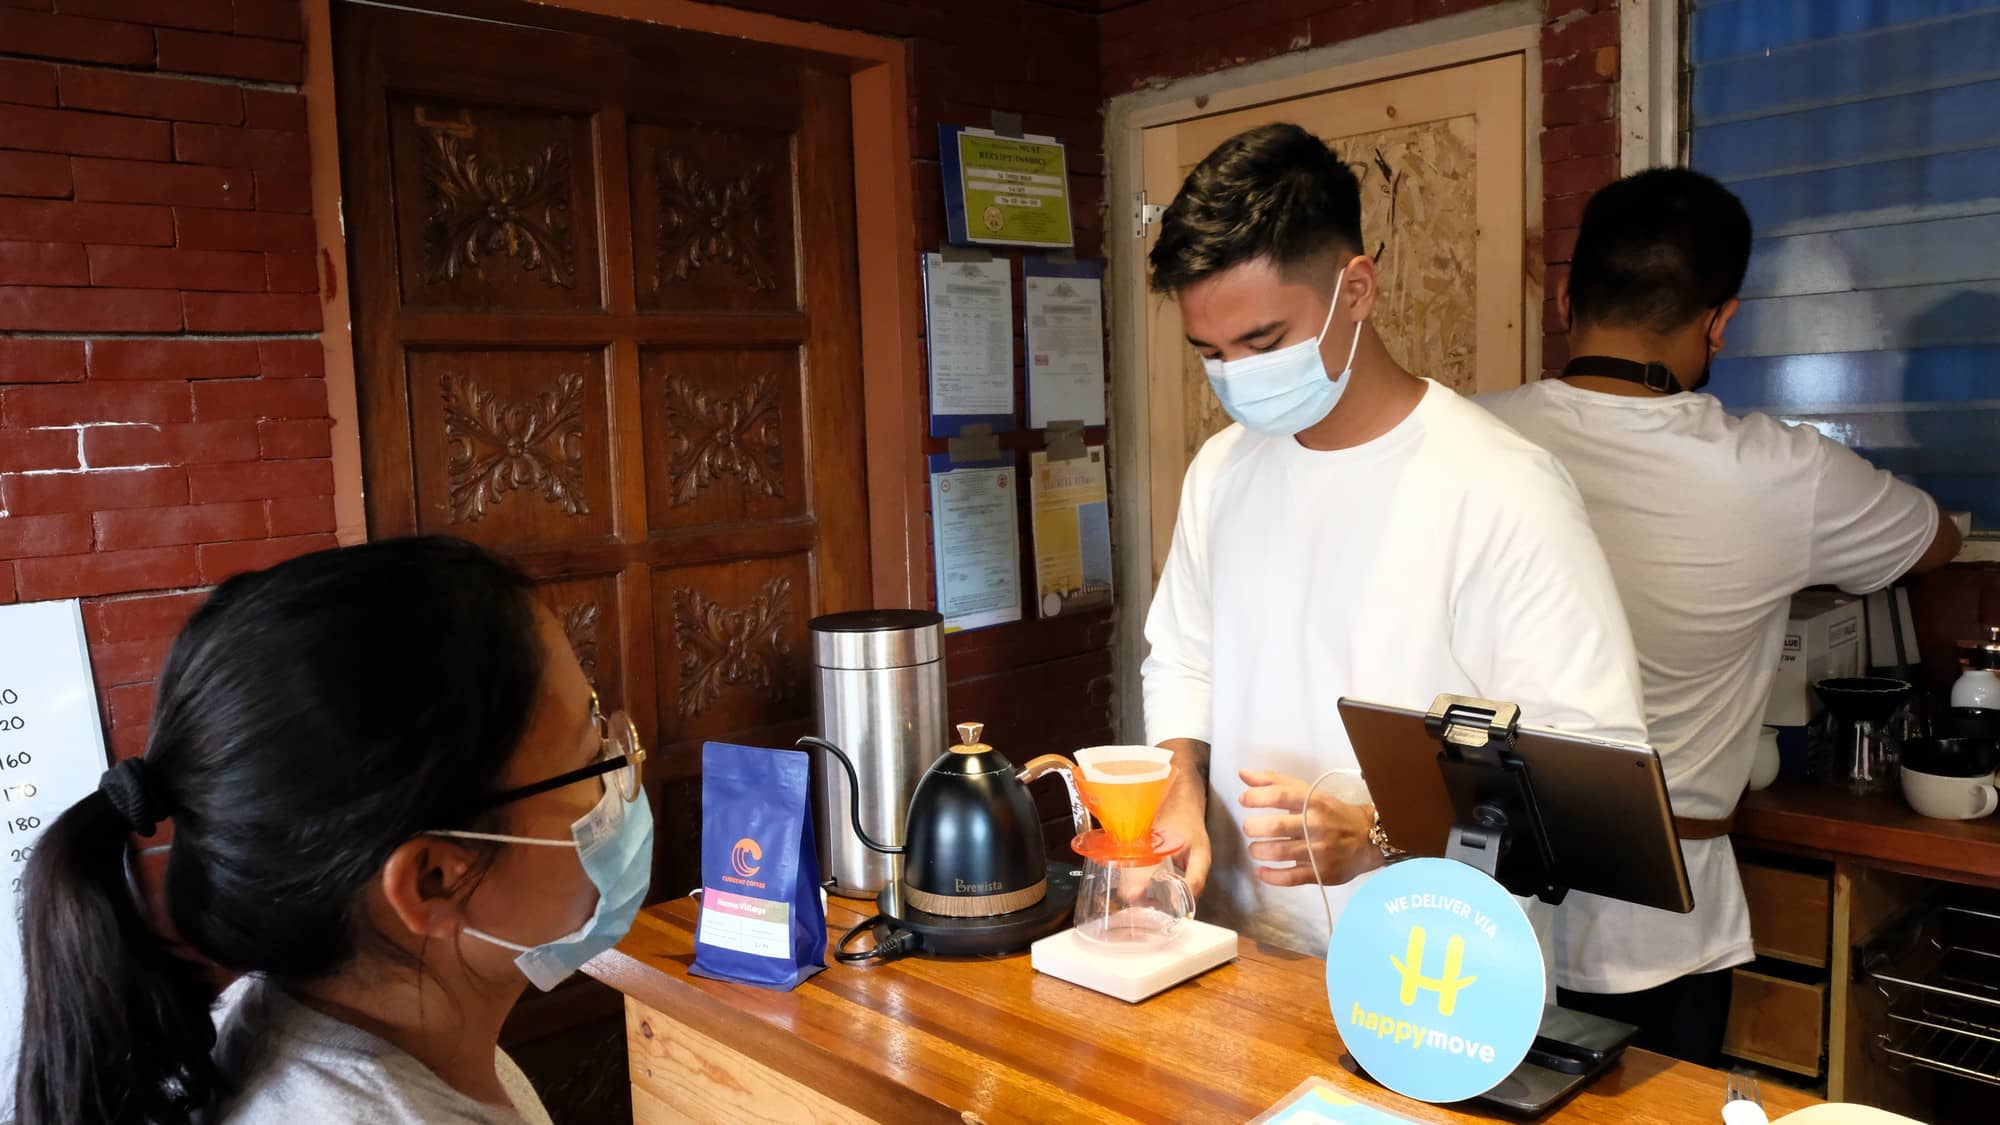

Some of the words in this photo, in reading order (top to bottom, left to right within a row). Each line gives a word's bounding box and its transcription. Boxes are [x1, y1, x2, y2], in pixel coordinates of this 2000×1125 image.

[1783, 639, 1799, 647] LUE
[8, 816, 41, 834] 180
[746, 879, 766, 889] COFFEE
[955, 878, 1003, 893] Brewista
[1384, 895, 1408, 914] WE
[1411, 893, 1472, 919] DELIVER
[1473, 911, 1497, 939] VIA
[1351, 1001, 1496, 1064] happymove
